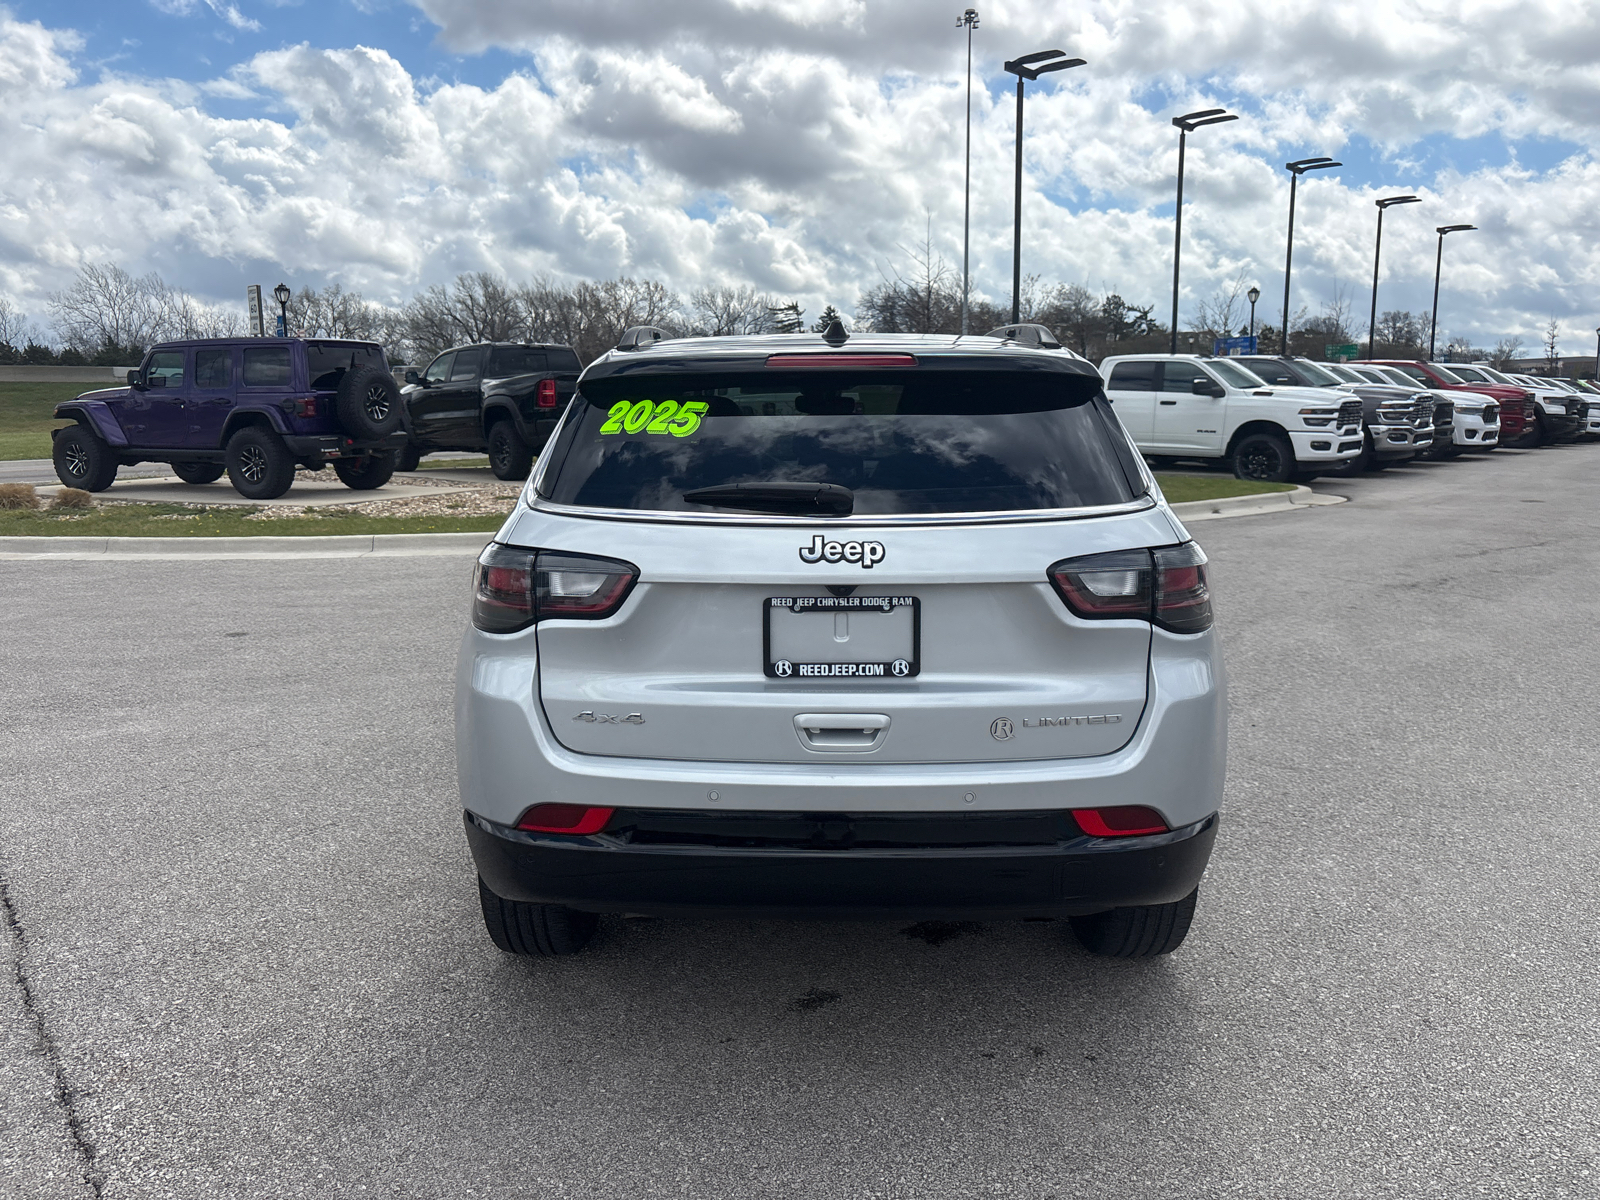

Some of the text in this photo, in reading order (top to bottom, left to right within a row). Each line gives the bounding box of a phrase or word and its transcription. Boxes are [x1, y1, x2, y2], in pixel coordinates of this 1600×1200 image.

[600, 399, 710, 437] 2025
[799, 535, 886, 569] Jeep
[771, 597, 913, 607] REED JEEP CHRYSLER DODGE RAM
[800, 664, 884, 676] REEDJEEP.COM
[1022, 713, 1122, 728] LIMITED
